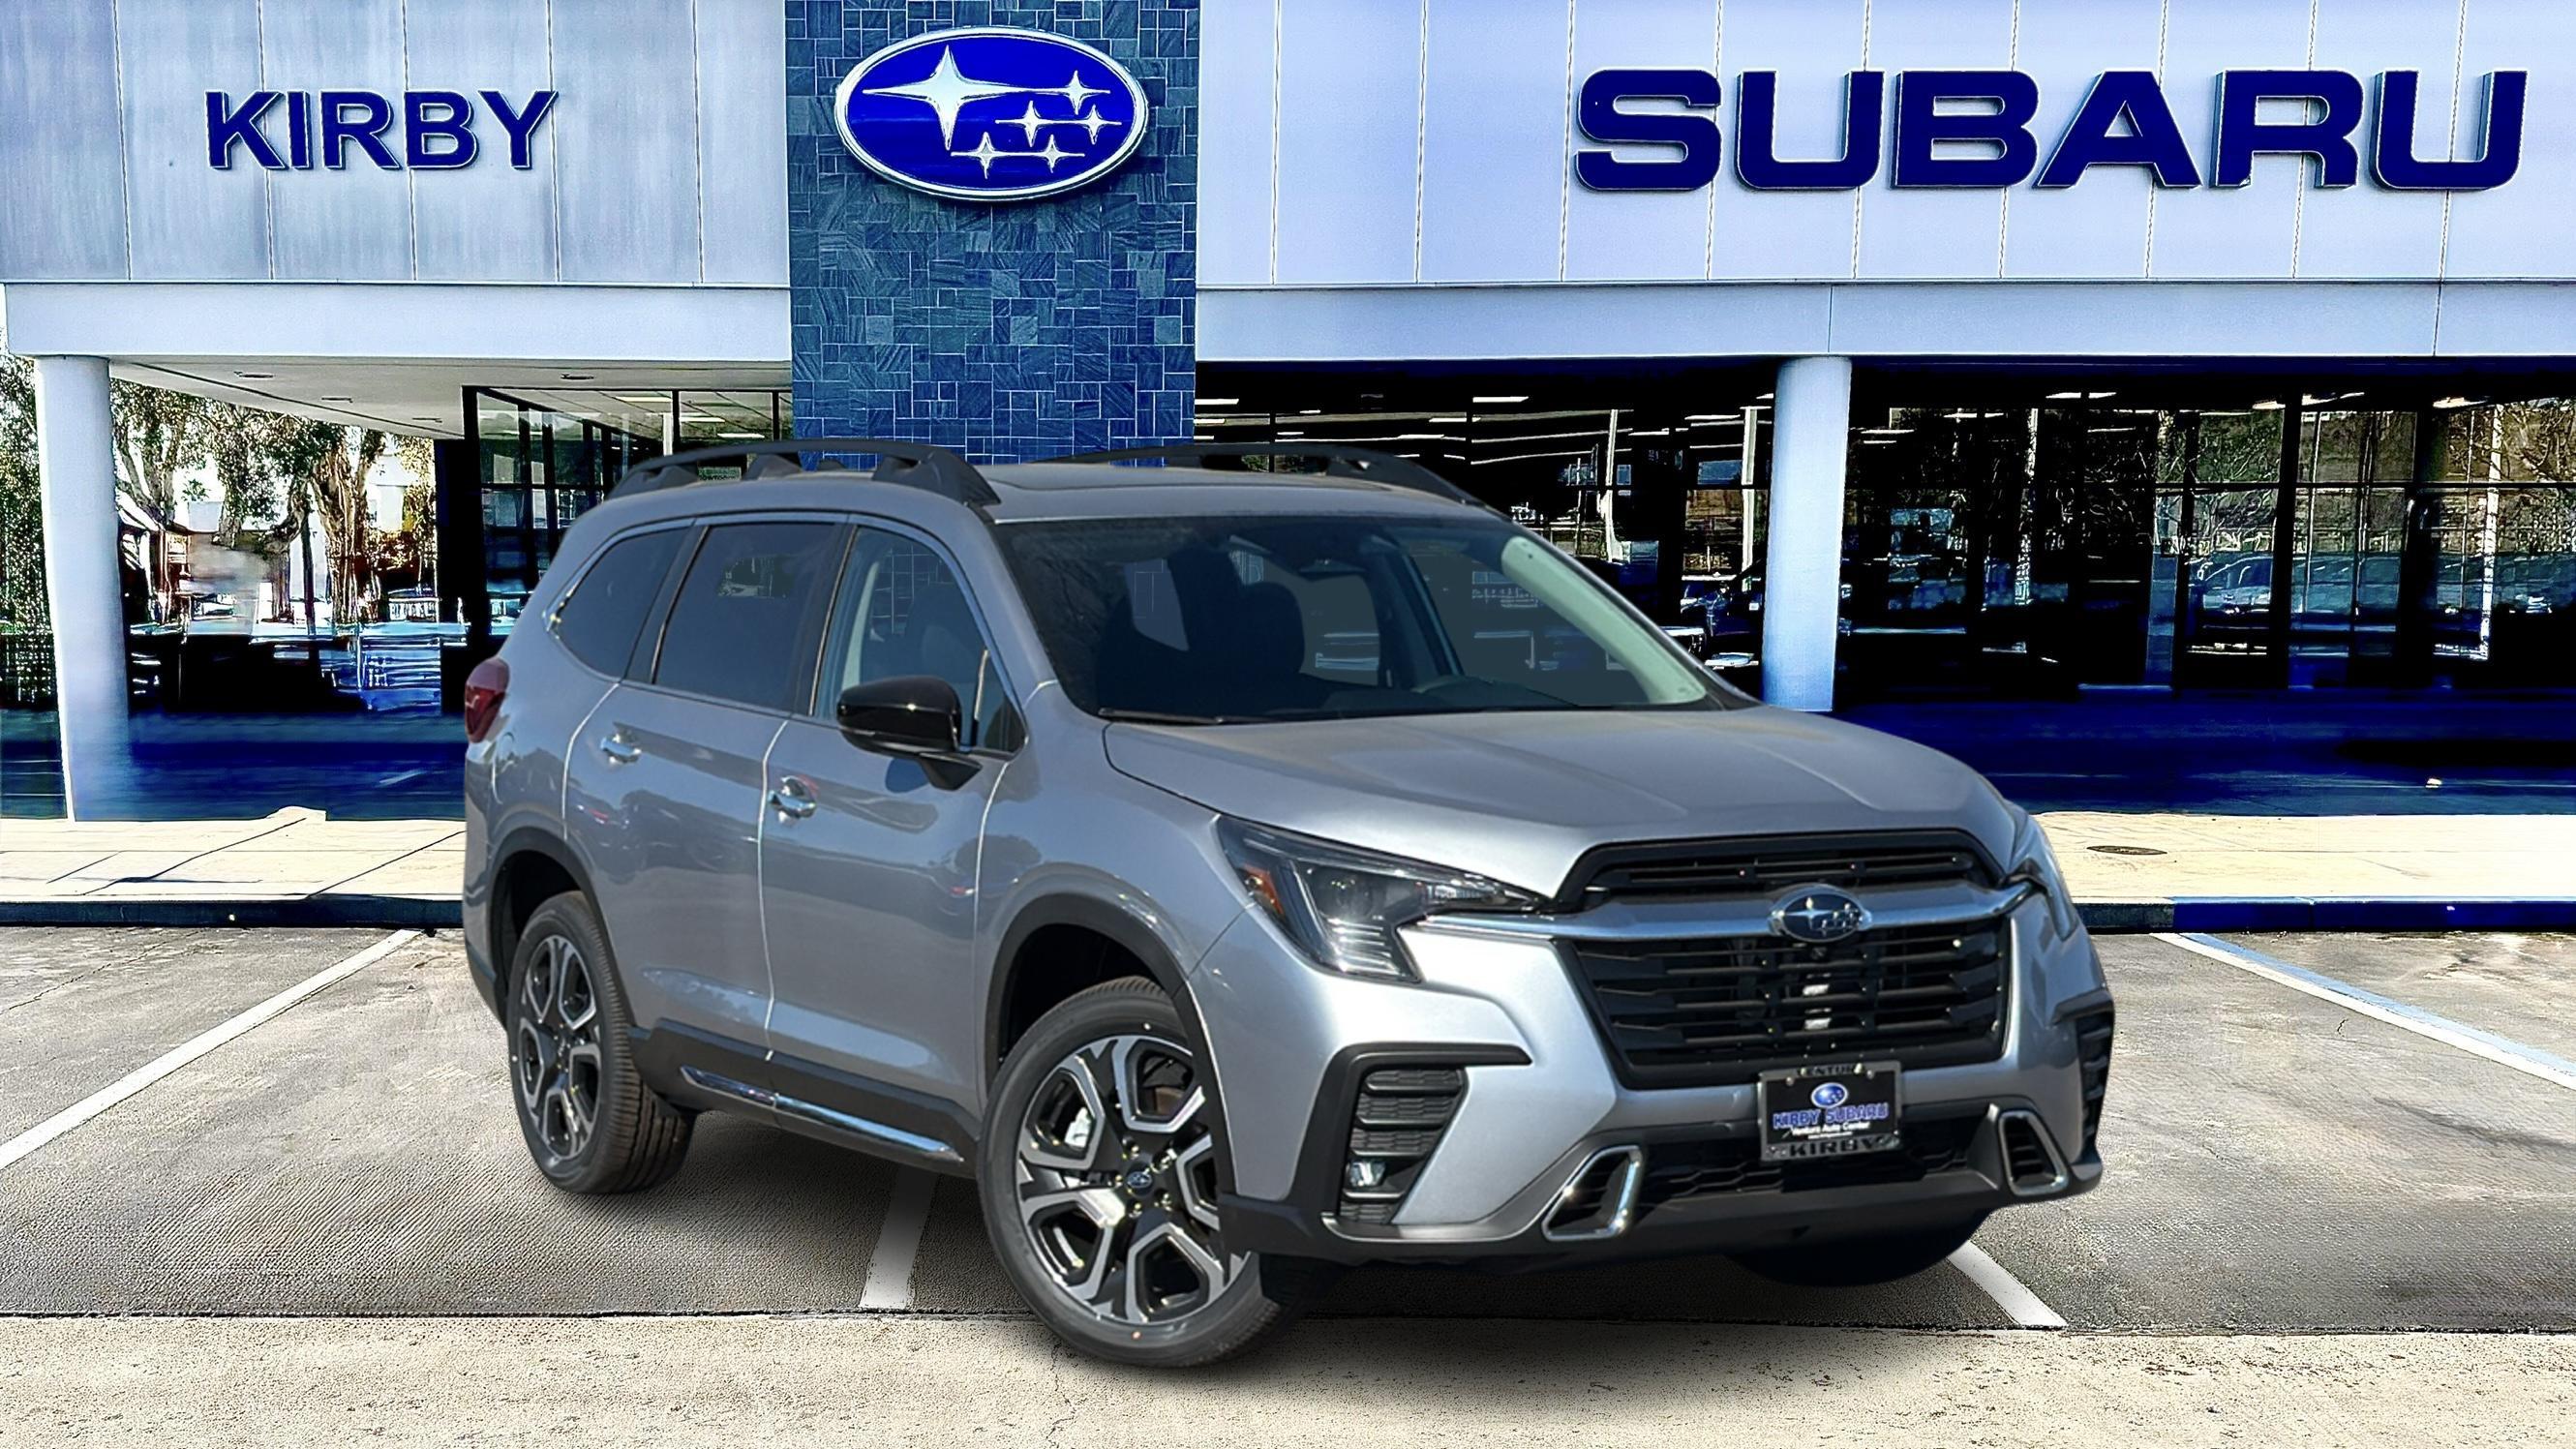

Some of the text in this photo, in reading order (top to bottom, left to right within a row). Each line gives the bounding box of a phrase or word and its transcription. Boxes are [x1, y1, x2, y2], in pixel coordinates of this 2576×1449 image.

[205, 89, 560, 169] KIRBY
[1574, 69, 2526, 193] SUBARU
[1773, 1102, 1889, 1130] KIRBY SUBARU
[1790, 1137, 1879, 1157] KIRBY
